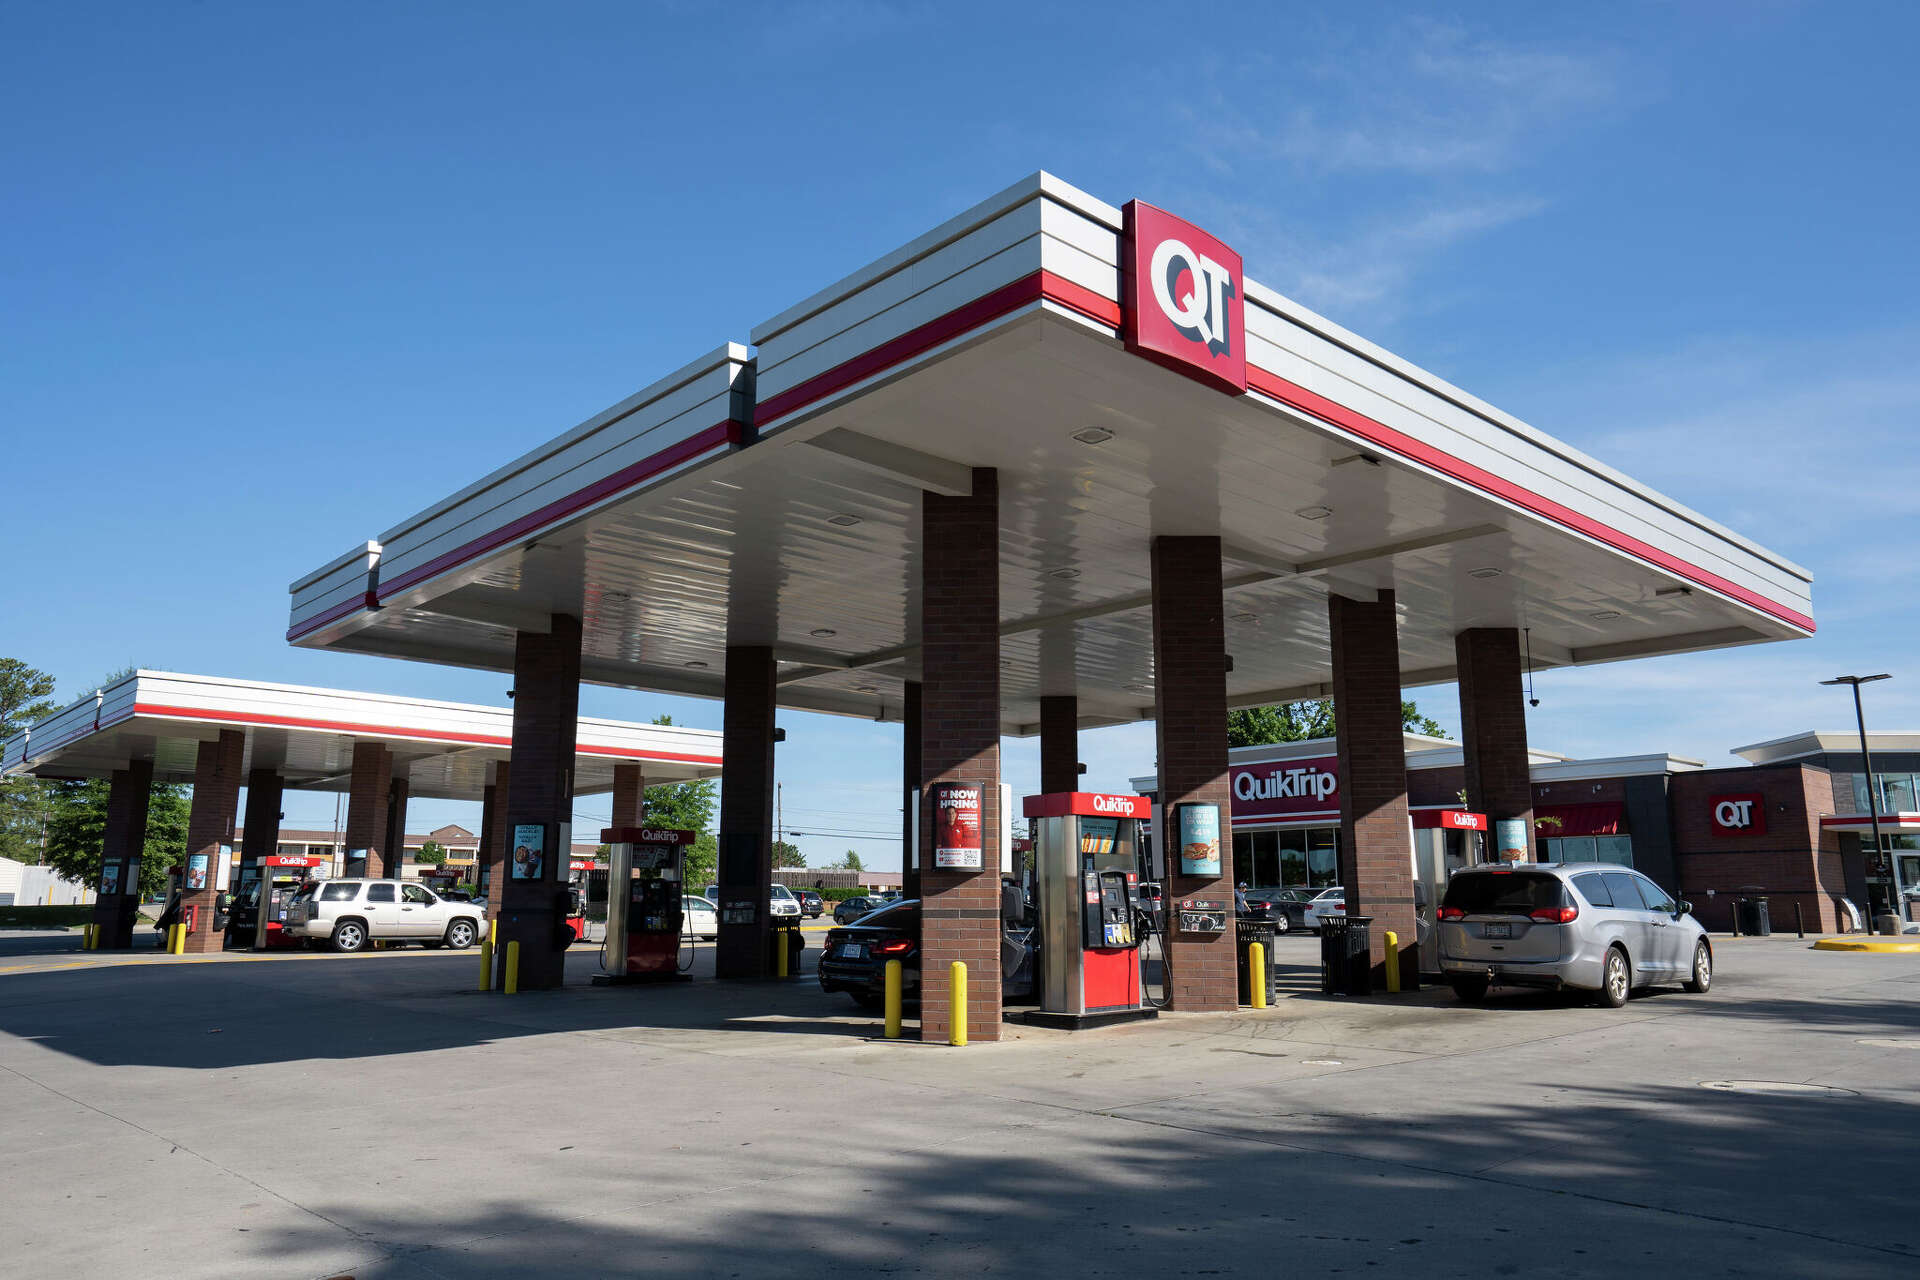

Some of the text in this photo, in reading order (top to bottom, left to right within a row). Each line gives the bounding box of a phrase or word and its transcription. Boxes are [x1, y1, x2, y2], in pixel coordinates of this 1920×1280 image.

[1150, 238, 1231, 346] QT
[1234, 767, 1337, 801] QuikTrip
[950, 790, 978, 799] NOW
[940, 800, 978, 808] HIRING
[1093, 795, 1134, 816] QuikTrip
[1454, 813, 1478, 828] QuikTrip
[1715, 800, 1753, 828] QT
[641, 829, 679, 844] QuikTrip
[280, 857, 308, 866] QuikTrip
